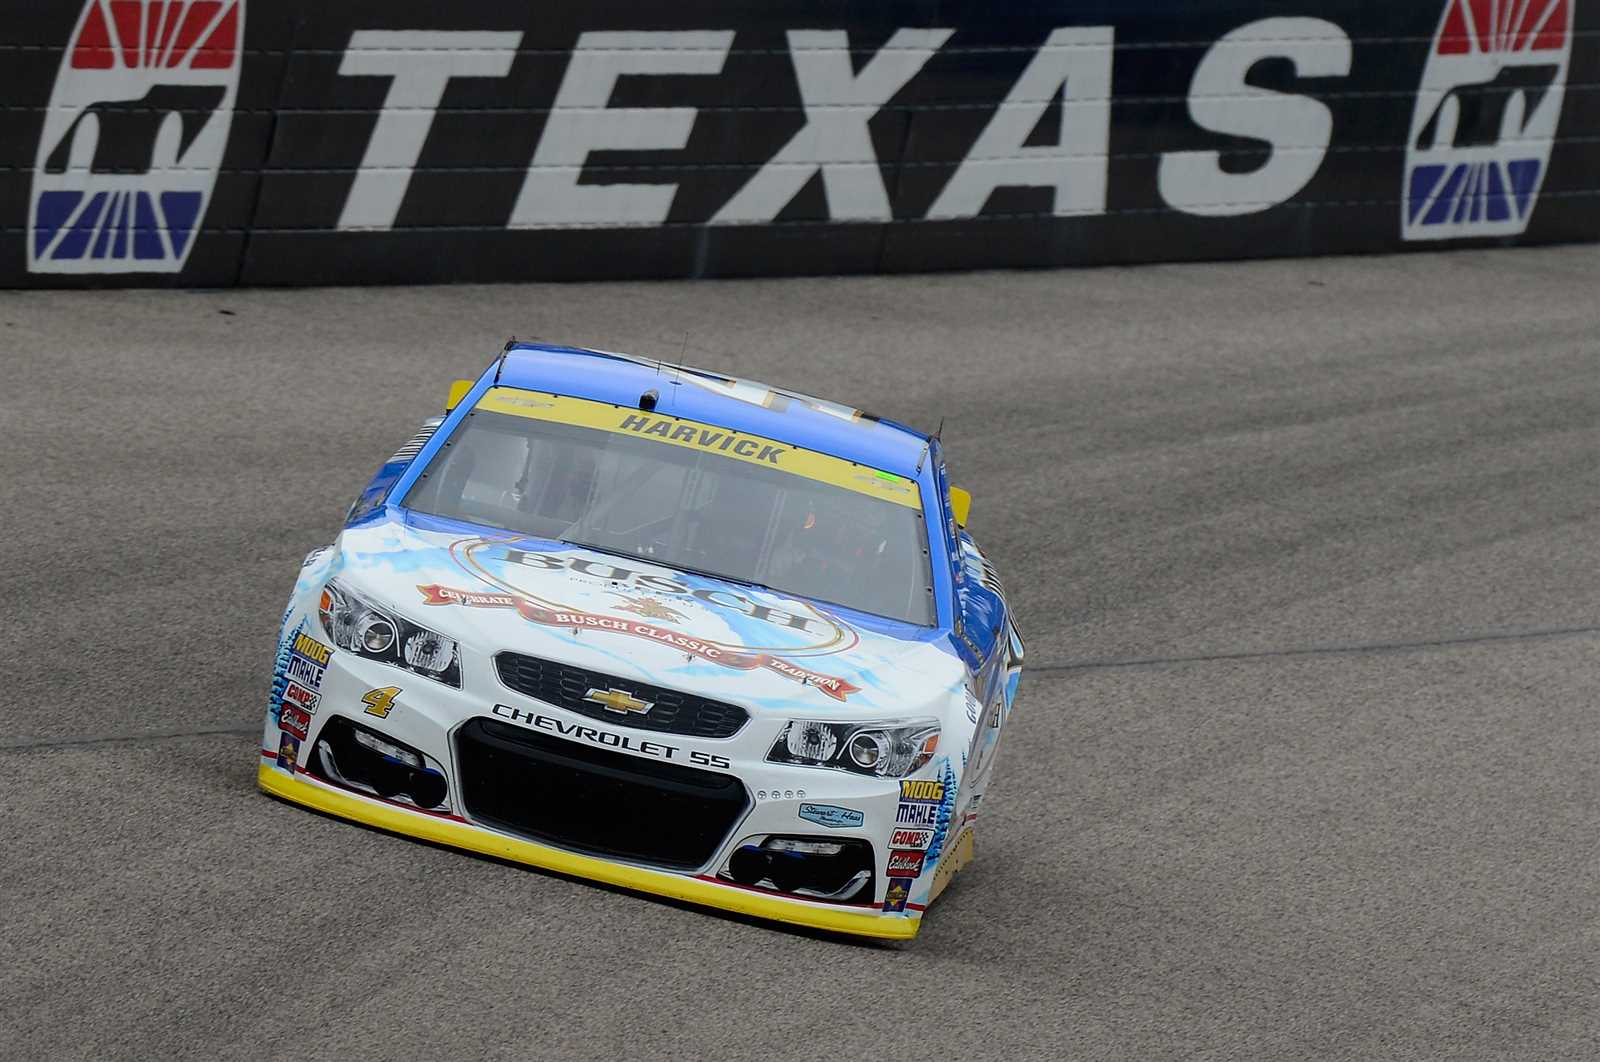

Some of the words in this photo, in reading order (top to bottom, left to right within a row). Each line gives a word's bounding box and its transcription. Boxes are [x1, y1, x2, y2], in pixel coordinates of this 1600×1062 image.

[336, 17, 1353, 232] TEXAS
[619, 413, 786, 465] HARVICK
[493, 549, 823, 633] BUSCH
[294, 634, 330, 666] MOOG
[555, 612, 629, 633] BUSCH
[633, 624, 722, 660] CLASSIC
[288, 657, 324, 689] MAHLE
[361, 686, 402, 719] 4
[492, 703, 680, 760] CHEVROLET
[690, 751, 731, 770] SS
[902, 781, 944, 800] MOOG
[896, 804, 937, 825] MAHLE
[892, 830, 921, 846] COMP
